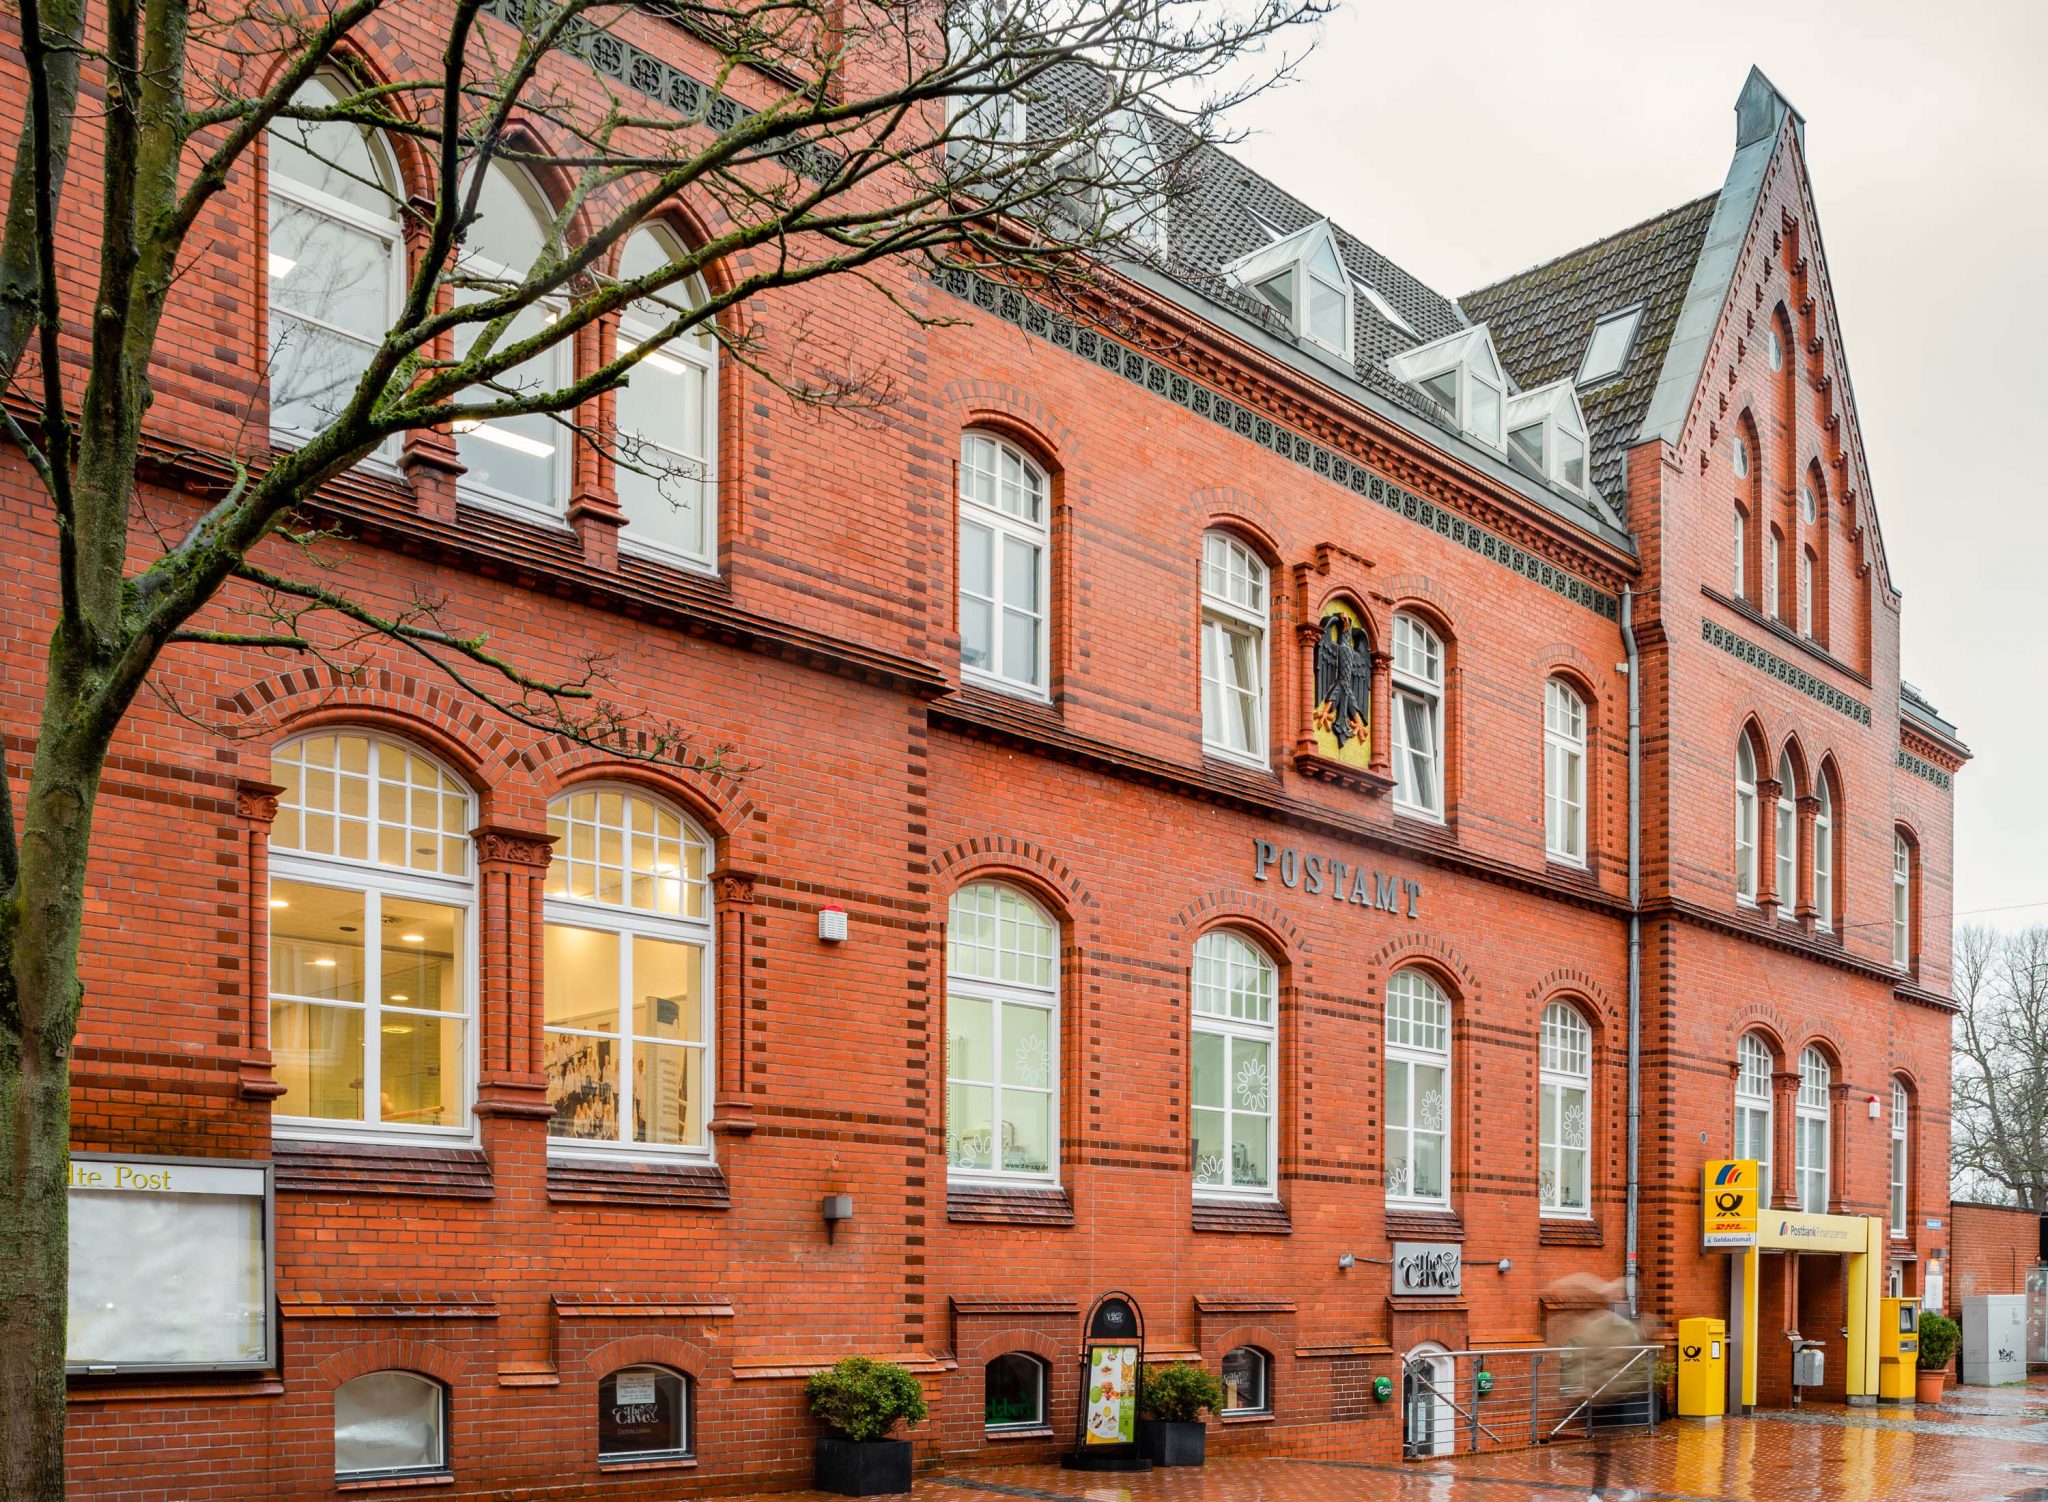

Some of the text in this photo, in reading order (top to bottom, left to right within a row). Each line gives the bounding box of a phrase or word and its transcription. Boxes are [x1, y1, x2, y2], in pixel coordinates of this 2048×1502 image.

[1254, 838, 1422, 918] POSTAMT
[67, 1161, 171, 1190] lte Post
[1713, 1235, 1752, 1243] Geldautomat
[1790, 1224, 1817, 1237] Postbank
[1399, 1257, 1450, 1289] Cave
[612, 1408, 652, 1424] Cave
